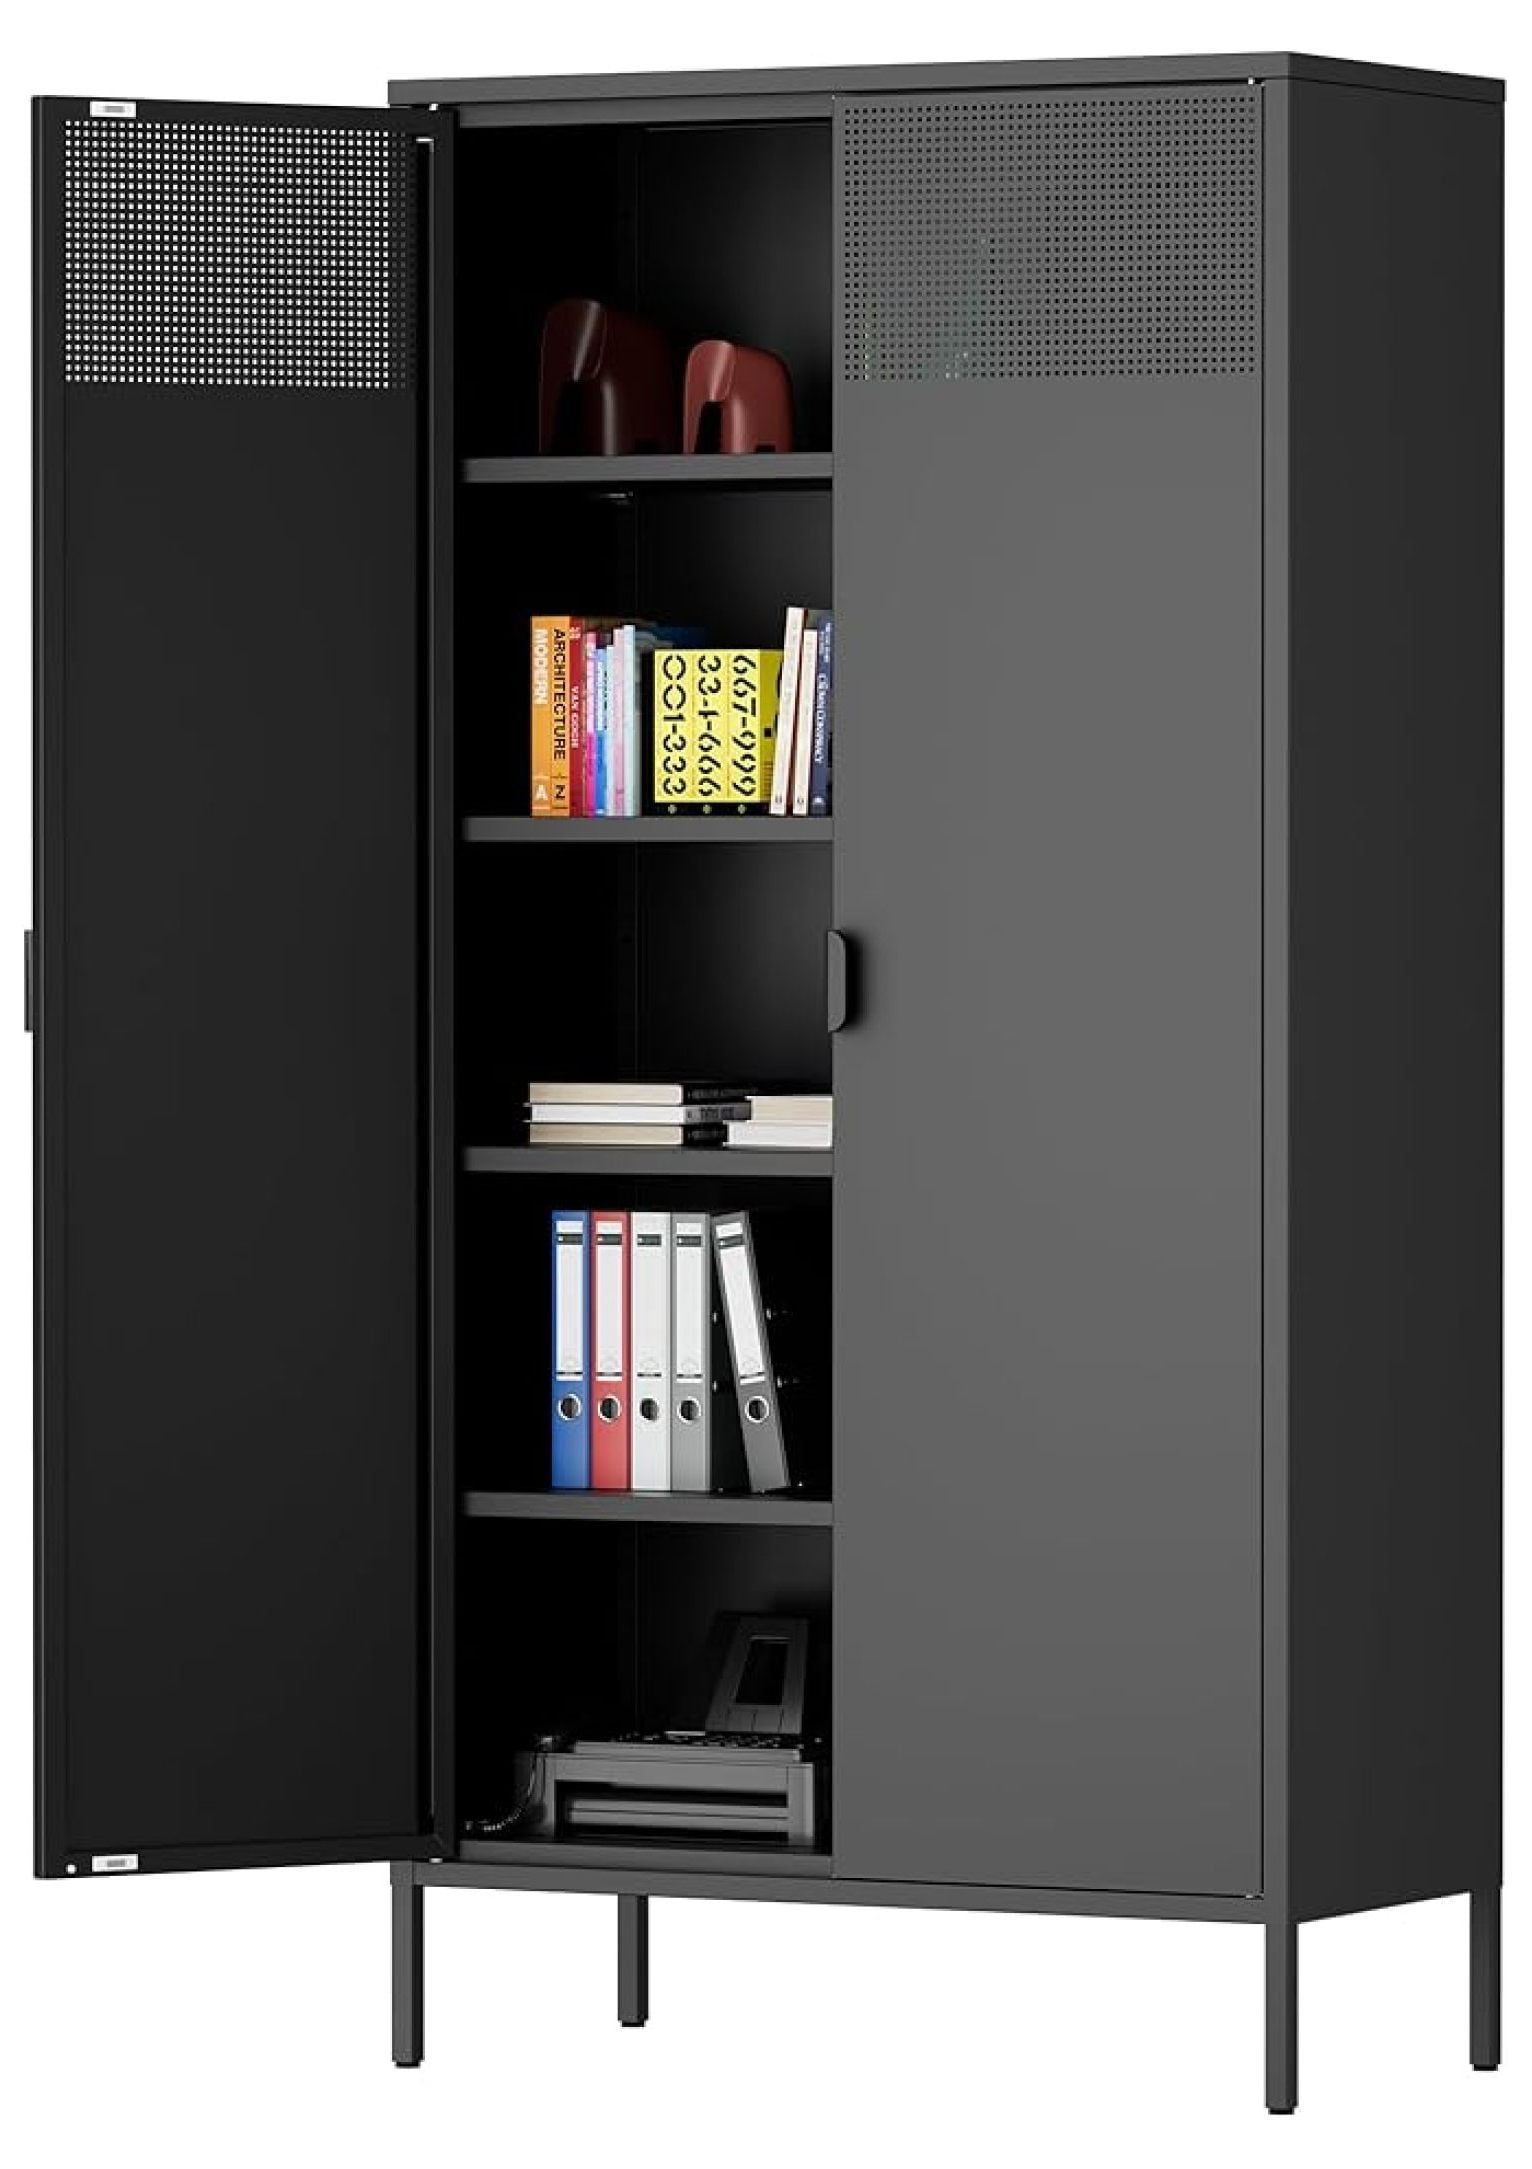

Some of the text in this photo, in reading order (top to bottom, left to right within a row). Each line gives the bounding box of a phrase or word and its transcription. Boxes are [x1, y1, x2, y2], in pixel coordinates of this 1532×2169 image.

[533, 628, 549, 705] MODERN
[554, 628, 566, 761] ARCHITECTURE
[571, 686, 580, 749] VAN GOGH
[663, 655, 687, 796] 001-333
[698, 655, 722, 797] 334-666
[732, 655, 757, 797] 667-999
[536, 784, 548, 800] A
